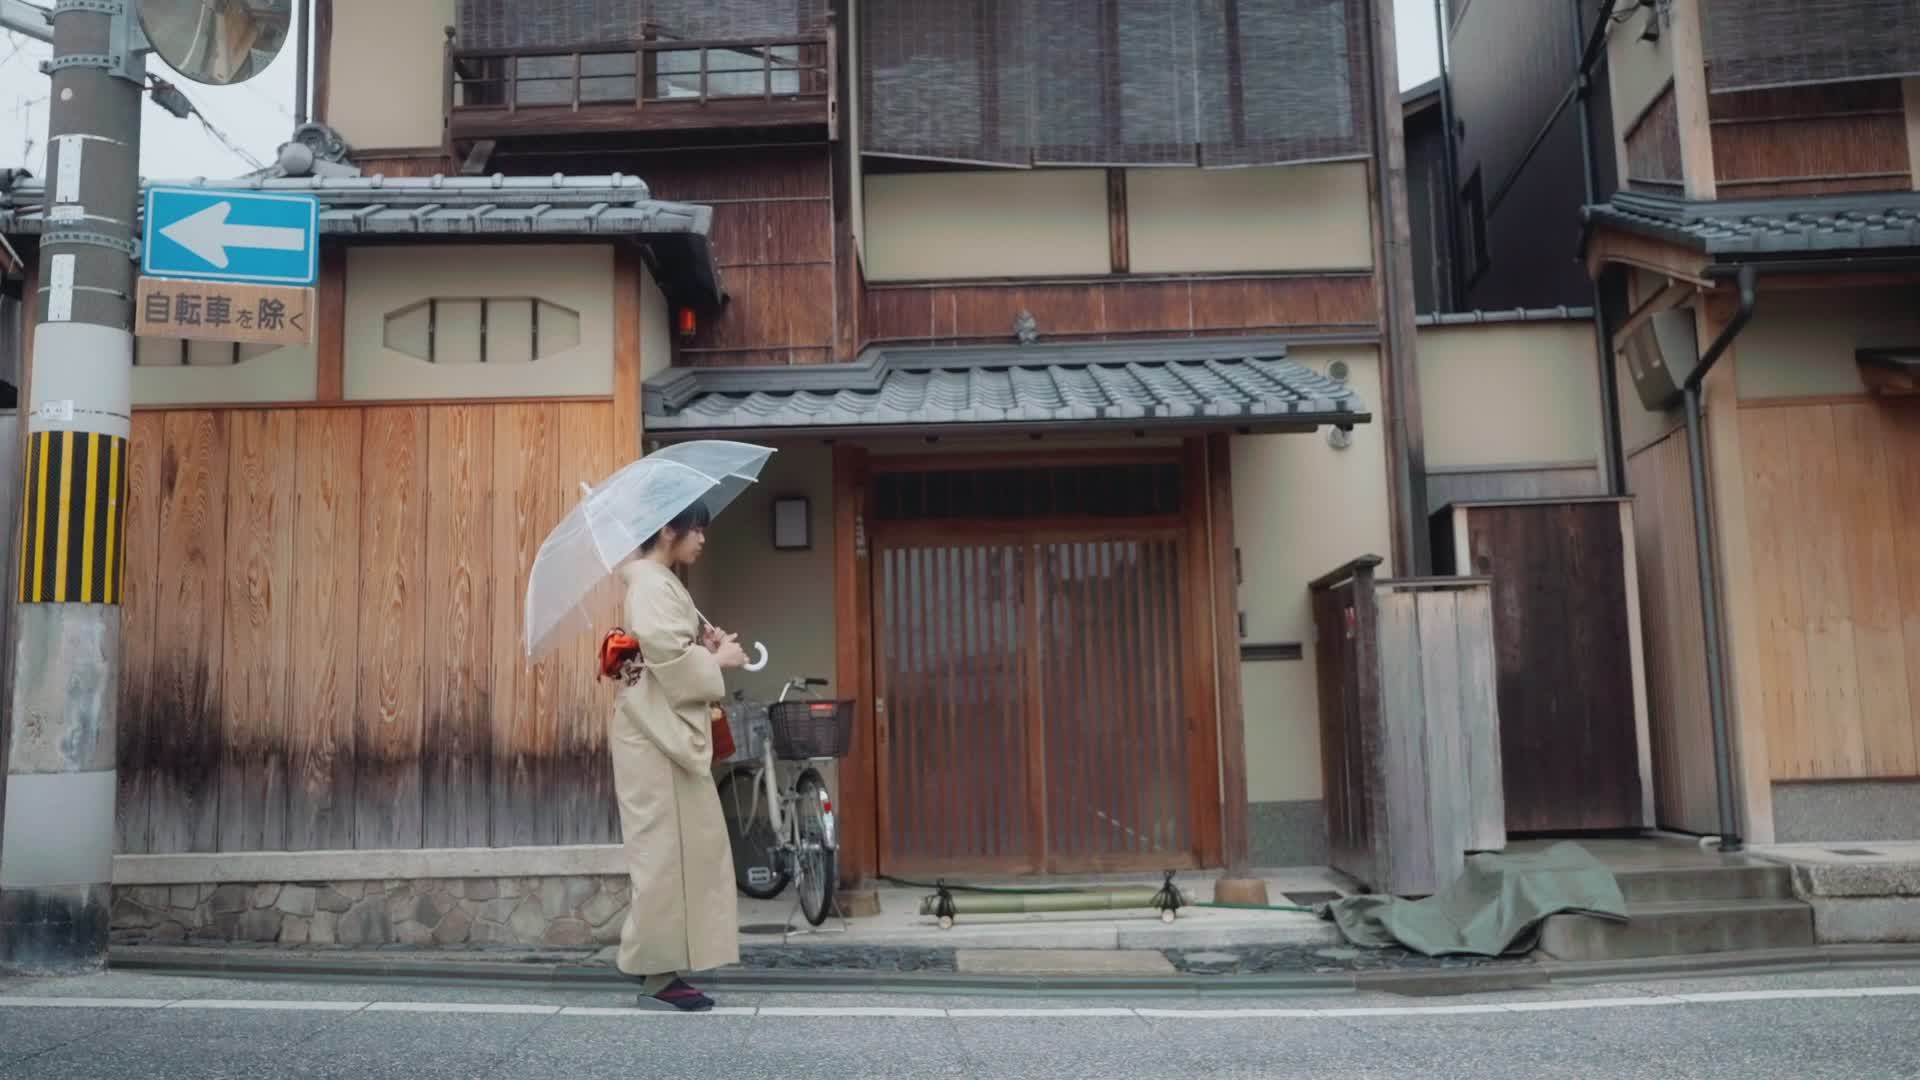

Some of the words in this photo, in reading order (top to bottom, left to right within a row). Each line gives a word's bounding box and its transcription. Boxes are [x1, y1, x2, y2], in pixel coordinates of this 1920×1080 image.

[145, 292, 305, 331] 自転車を除く
